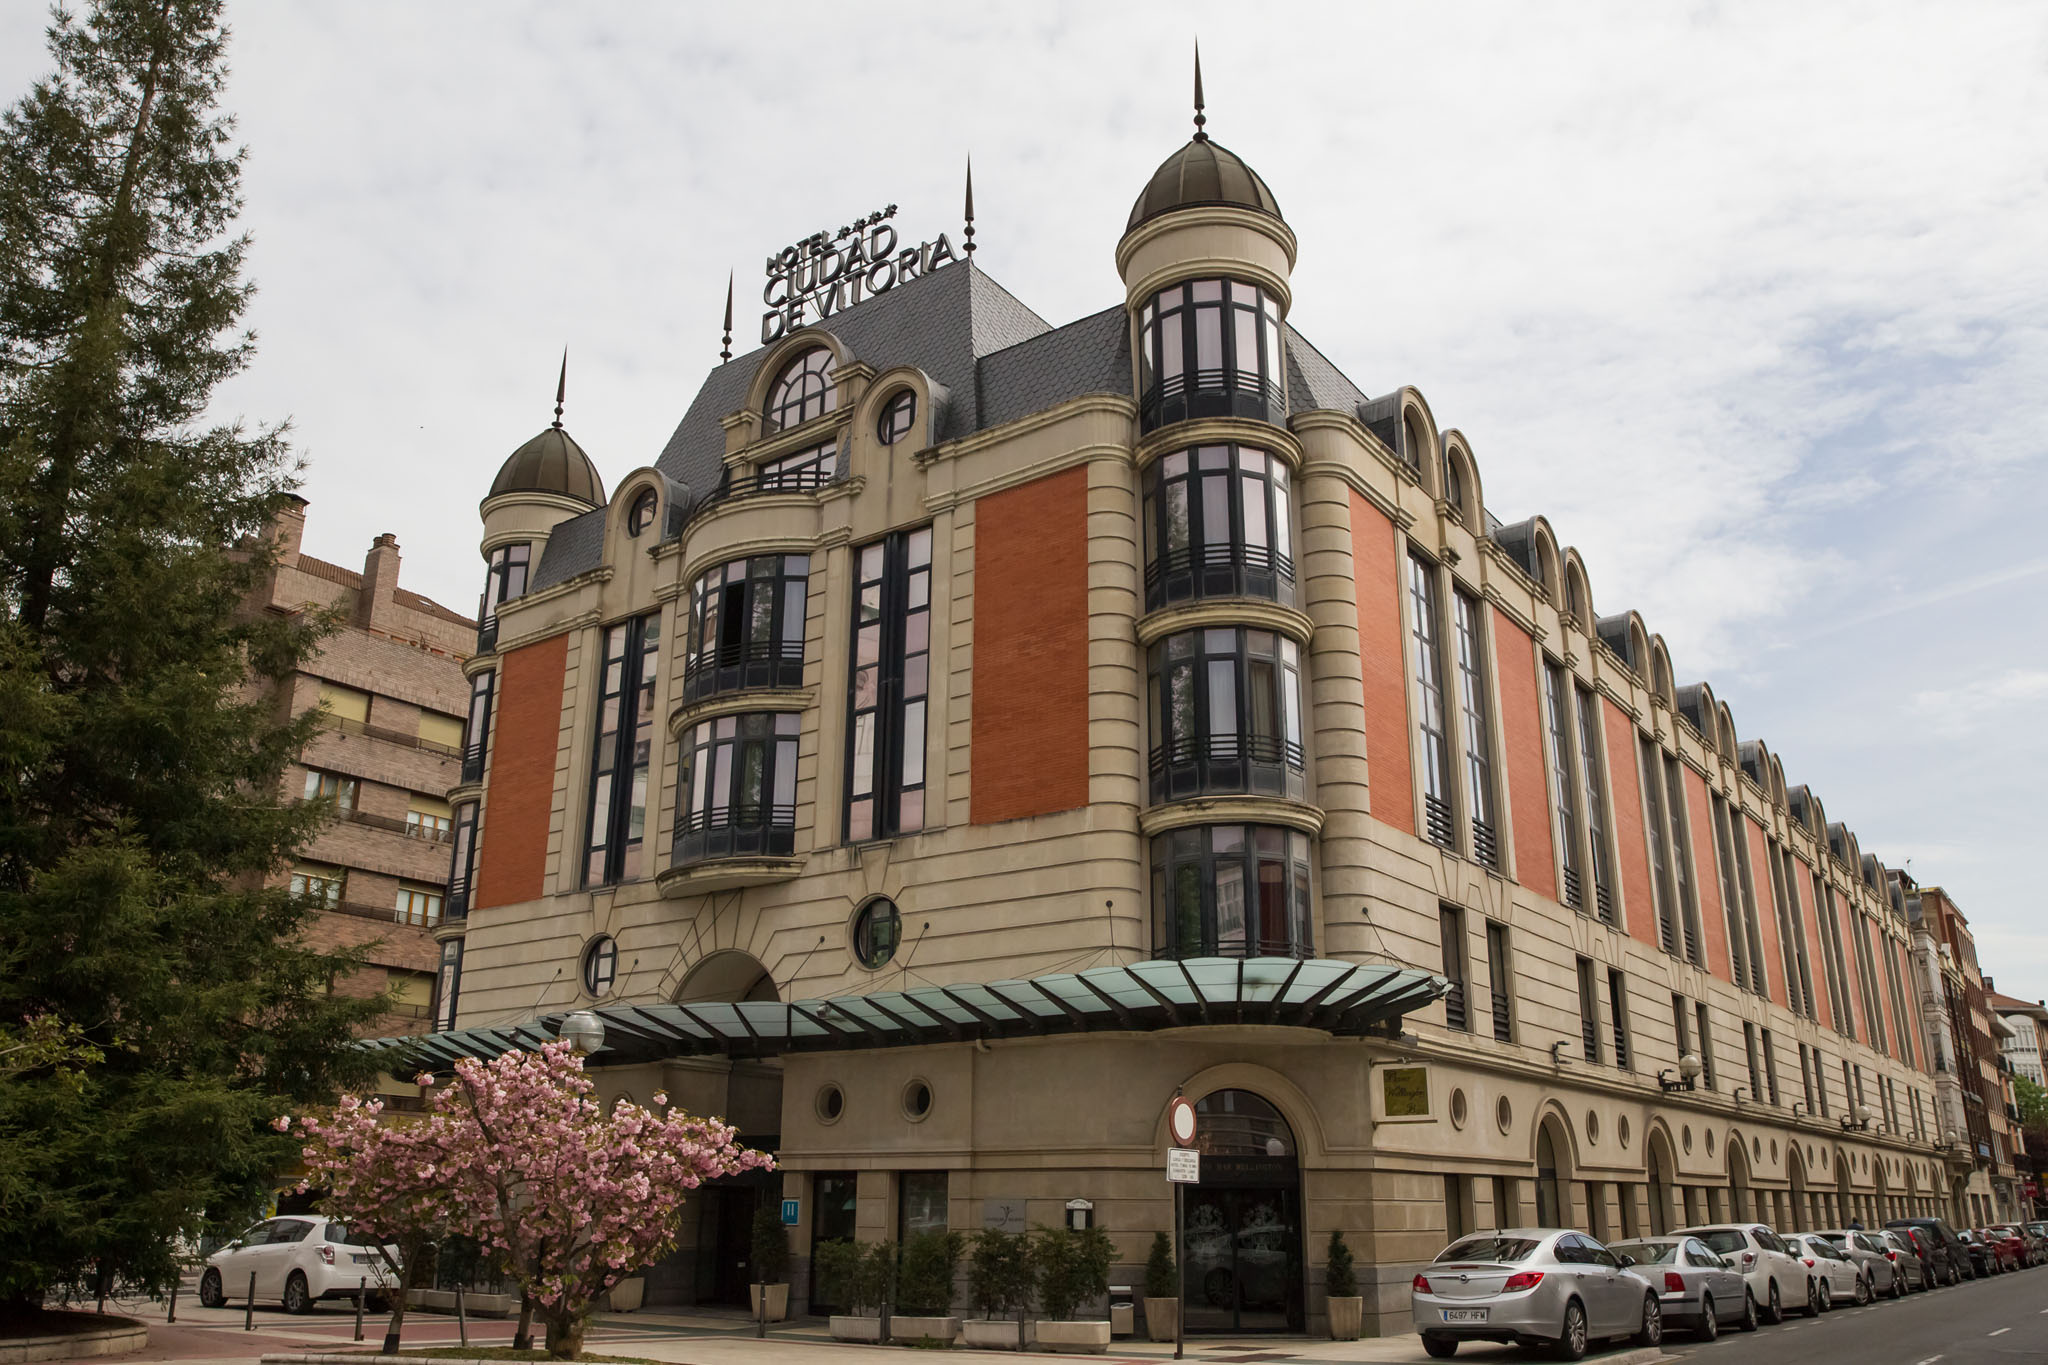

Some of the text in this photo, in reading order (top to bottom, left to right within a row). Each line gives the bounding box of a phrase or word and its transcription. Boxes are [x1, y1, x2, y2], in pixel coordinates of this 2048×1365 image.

[764, 225, 898, 307] CIUDAD
[766, 230, 835, 277] HOTEL
[761, 232, 958, 345] DE VITORIA
[1449, 1311, 1467, 1320] 6497
